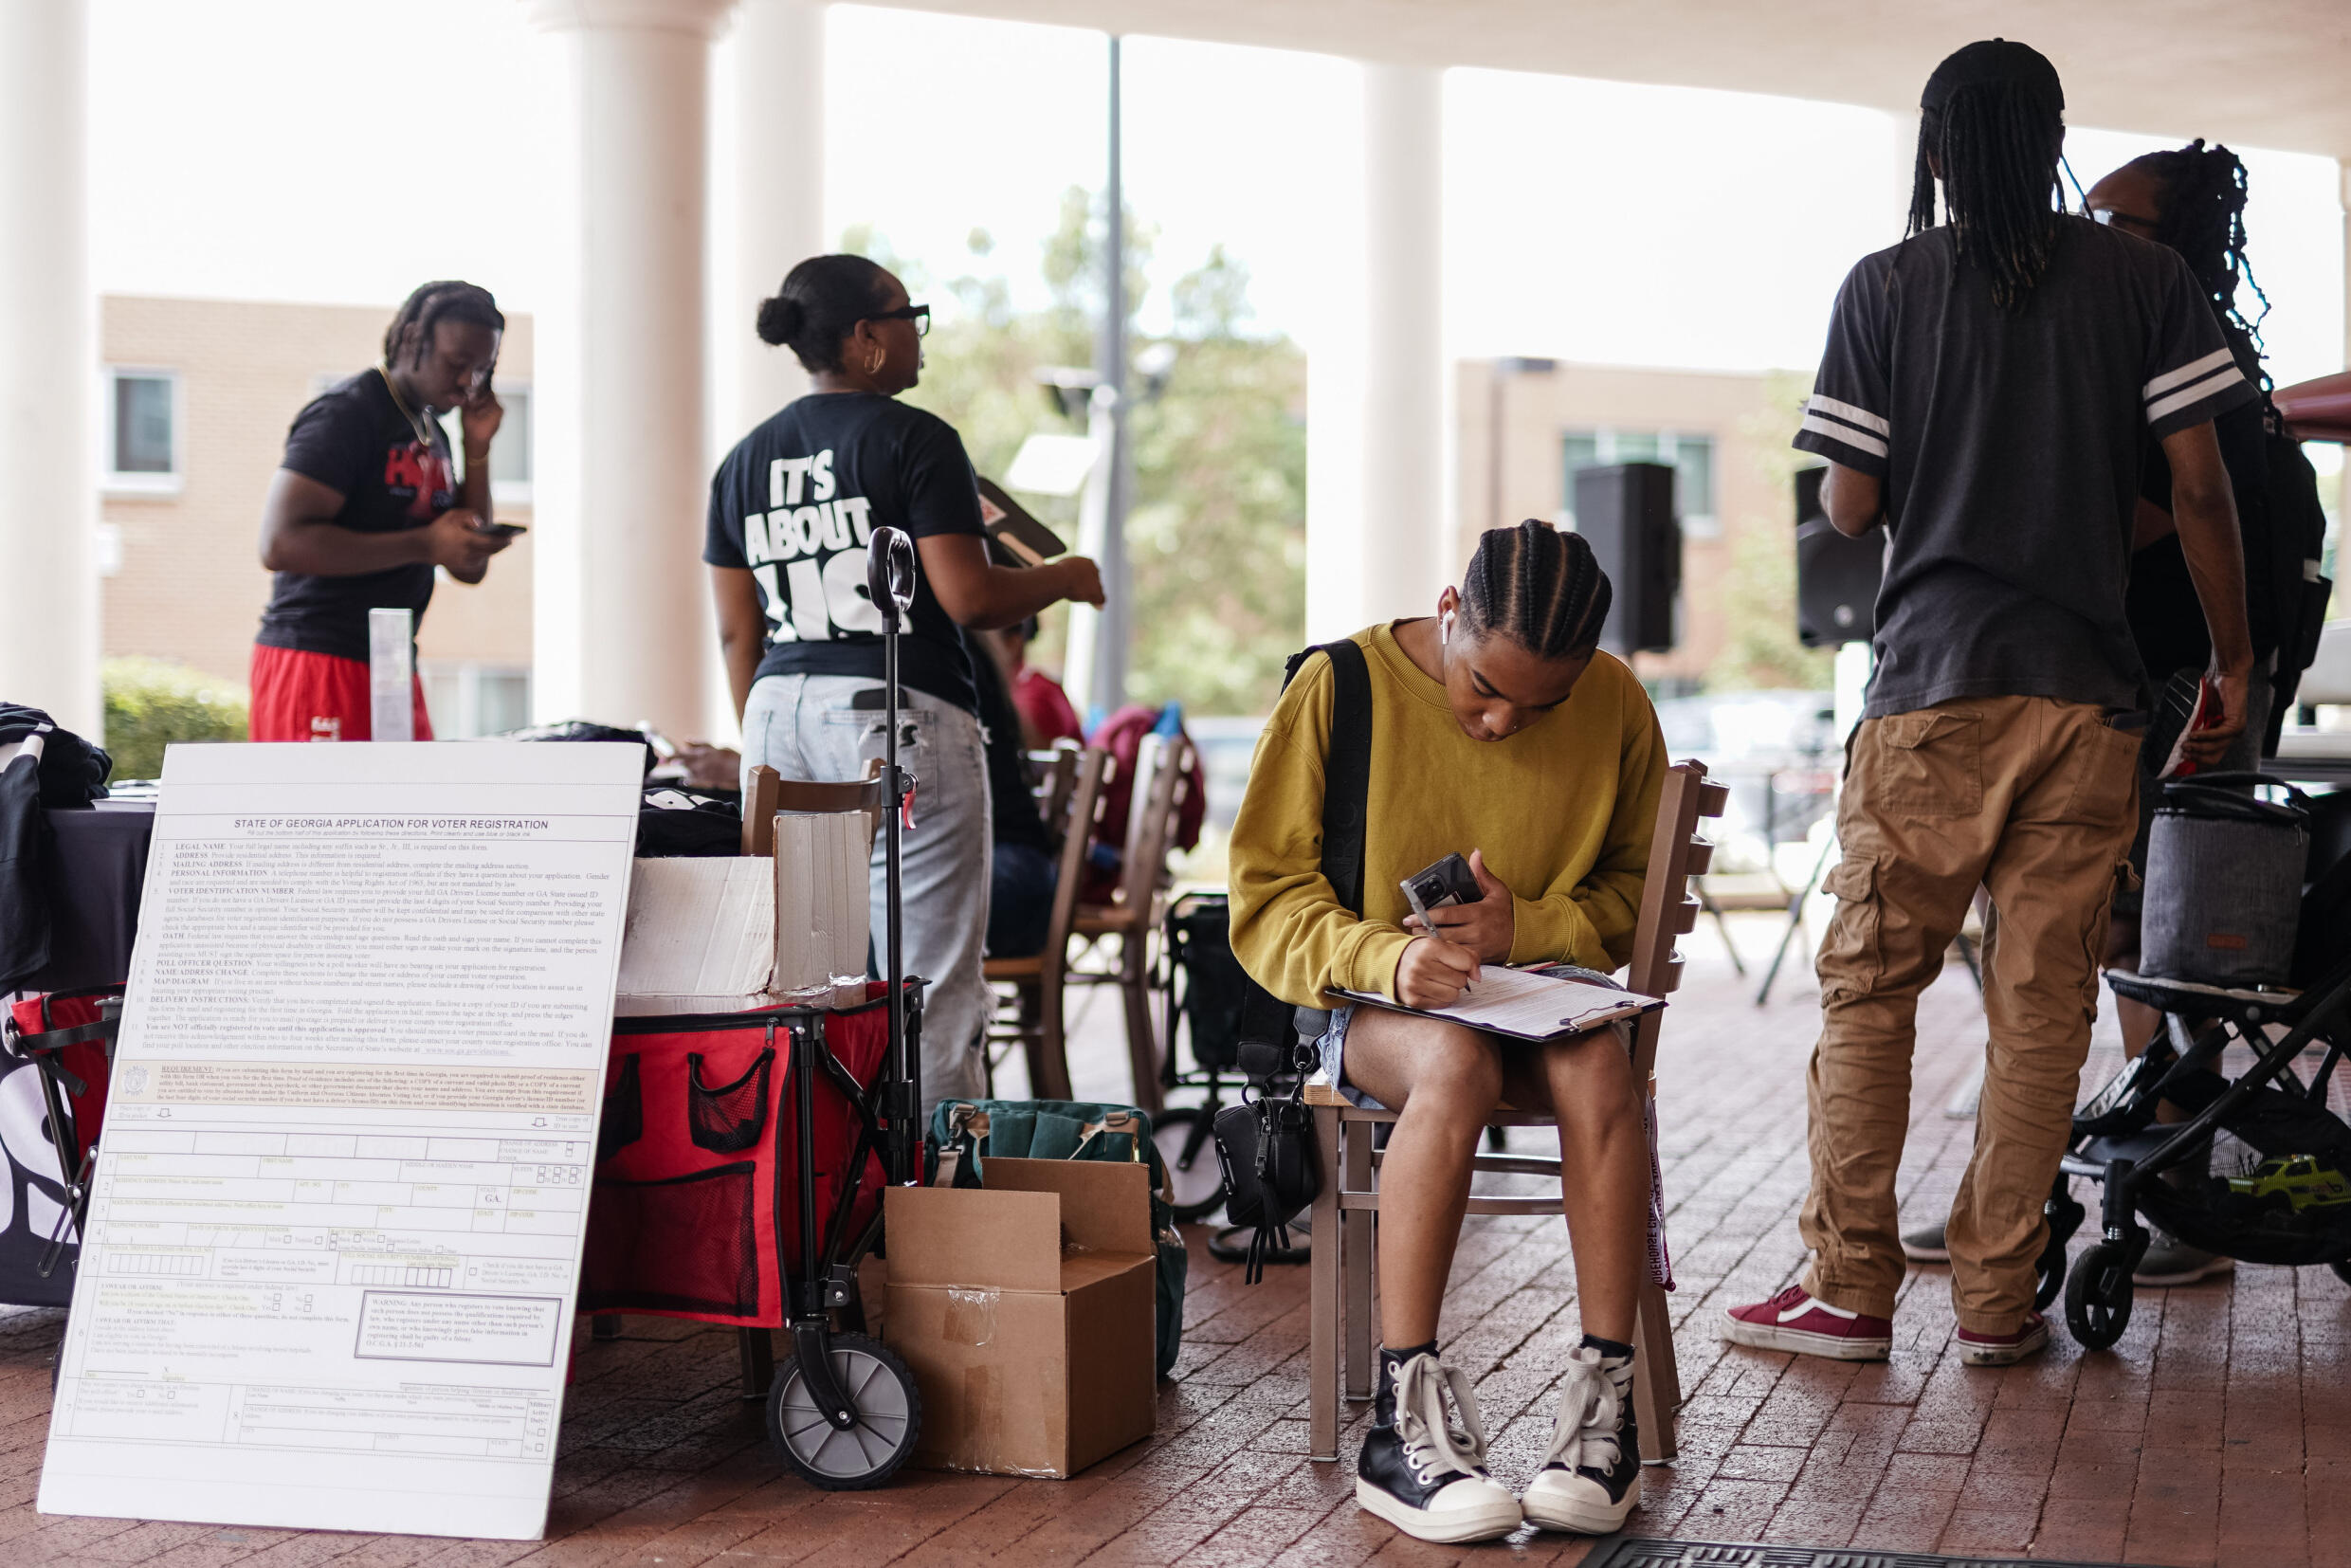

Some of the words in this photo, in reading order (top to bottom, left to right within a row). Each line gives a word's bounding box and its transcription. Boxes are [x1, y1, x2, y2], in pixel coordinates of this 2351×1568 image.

[770, 449, 836, 508] IT'S
[744, 496, 871, 567] ABOUT
[233, 819, 267, 828] STATE
[268, 819, 284, 828] OF
[285, 819, 334, 828] GEORGIA
[335, 819, 406, 828] APPLICATION
[406, 819, 429, 828] FOR
[430, 819, 468, 828] VOTER
[469, 820, 549, 829] REGISTRATION
